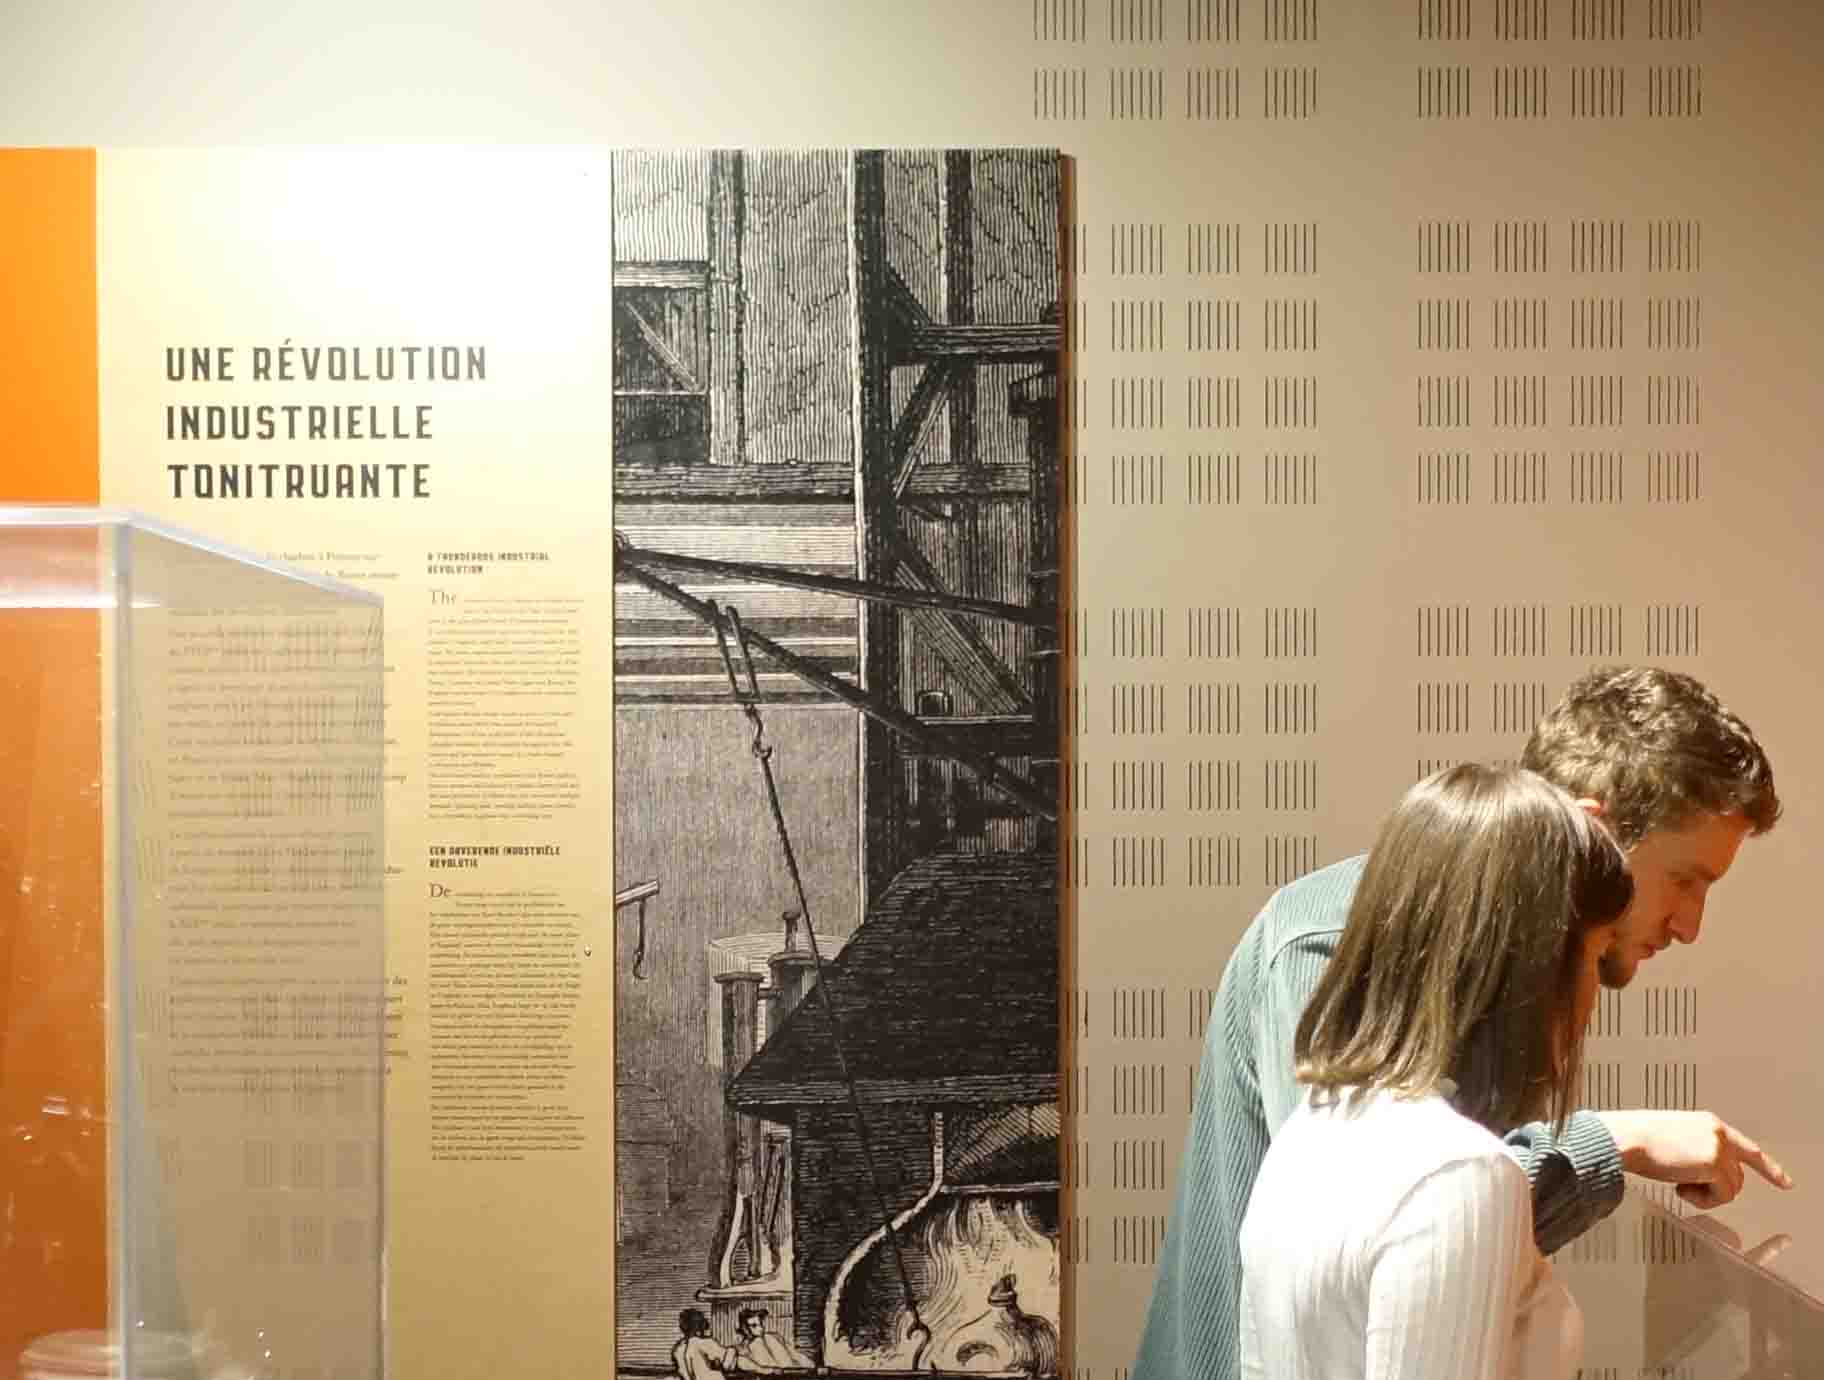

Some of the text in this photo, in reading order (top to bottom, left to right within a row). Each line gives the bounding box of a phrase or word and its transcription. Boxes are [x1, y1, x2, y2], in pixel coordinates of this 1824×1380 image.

[166, 339, 487, 381] UNE RÉVOLUTION
[166, 405, 433, 440] INDUSTRIELLE
[166, 464, 431, 499] TONITRUANTE
[498, 552, 550, 562] INDUSTRIAL
[427, 564, 484, 575] REVOLUTION
[428, 588, 457, 606] The
[429, 882, 452, 898] De
